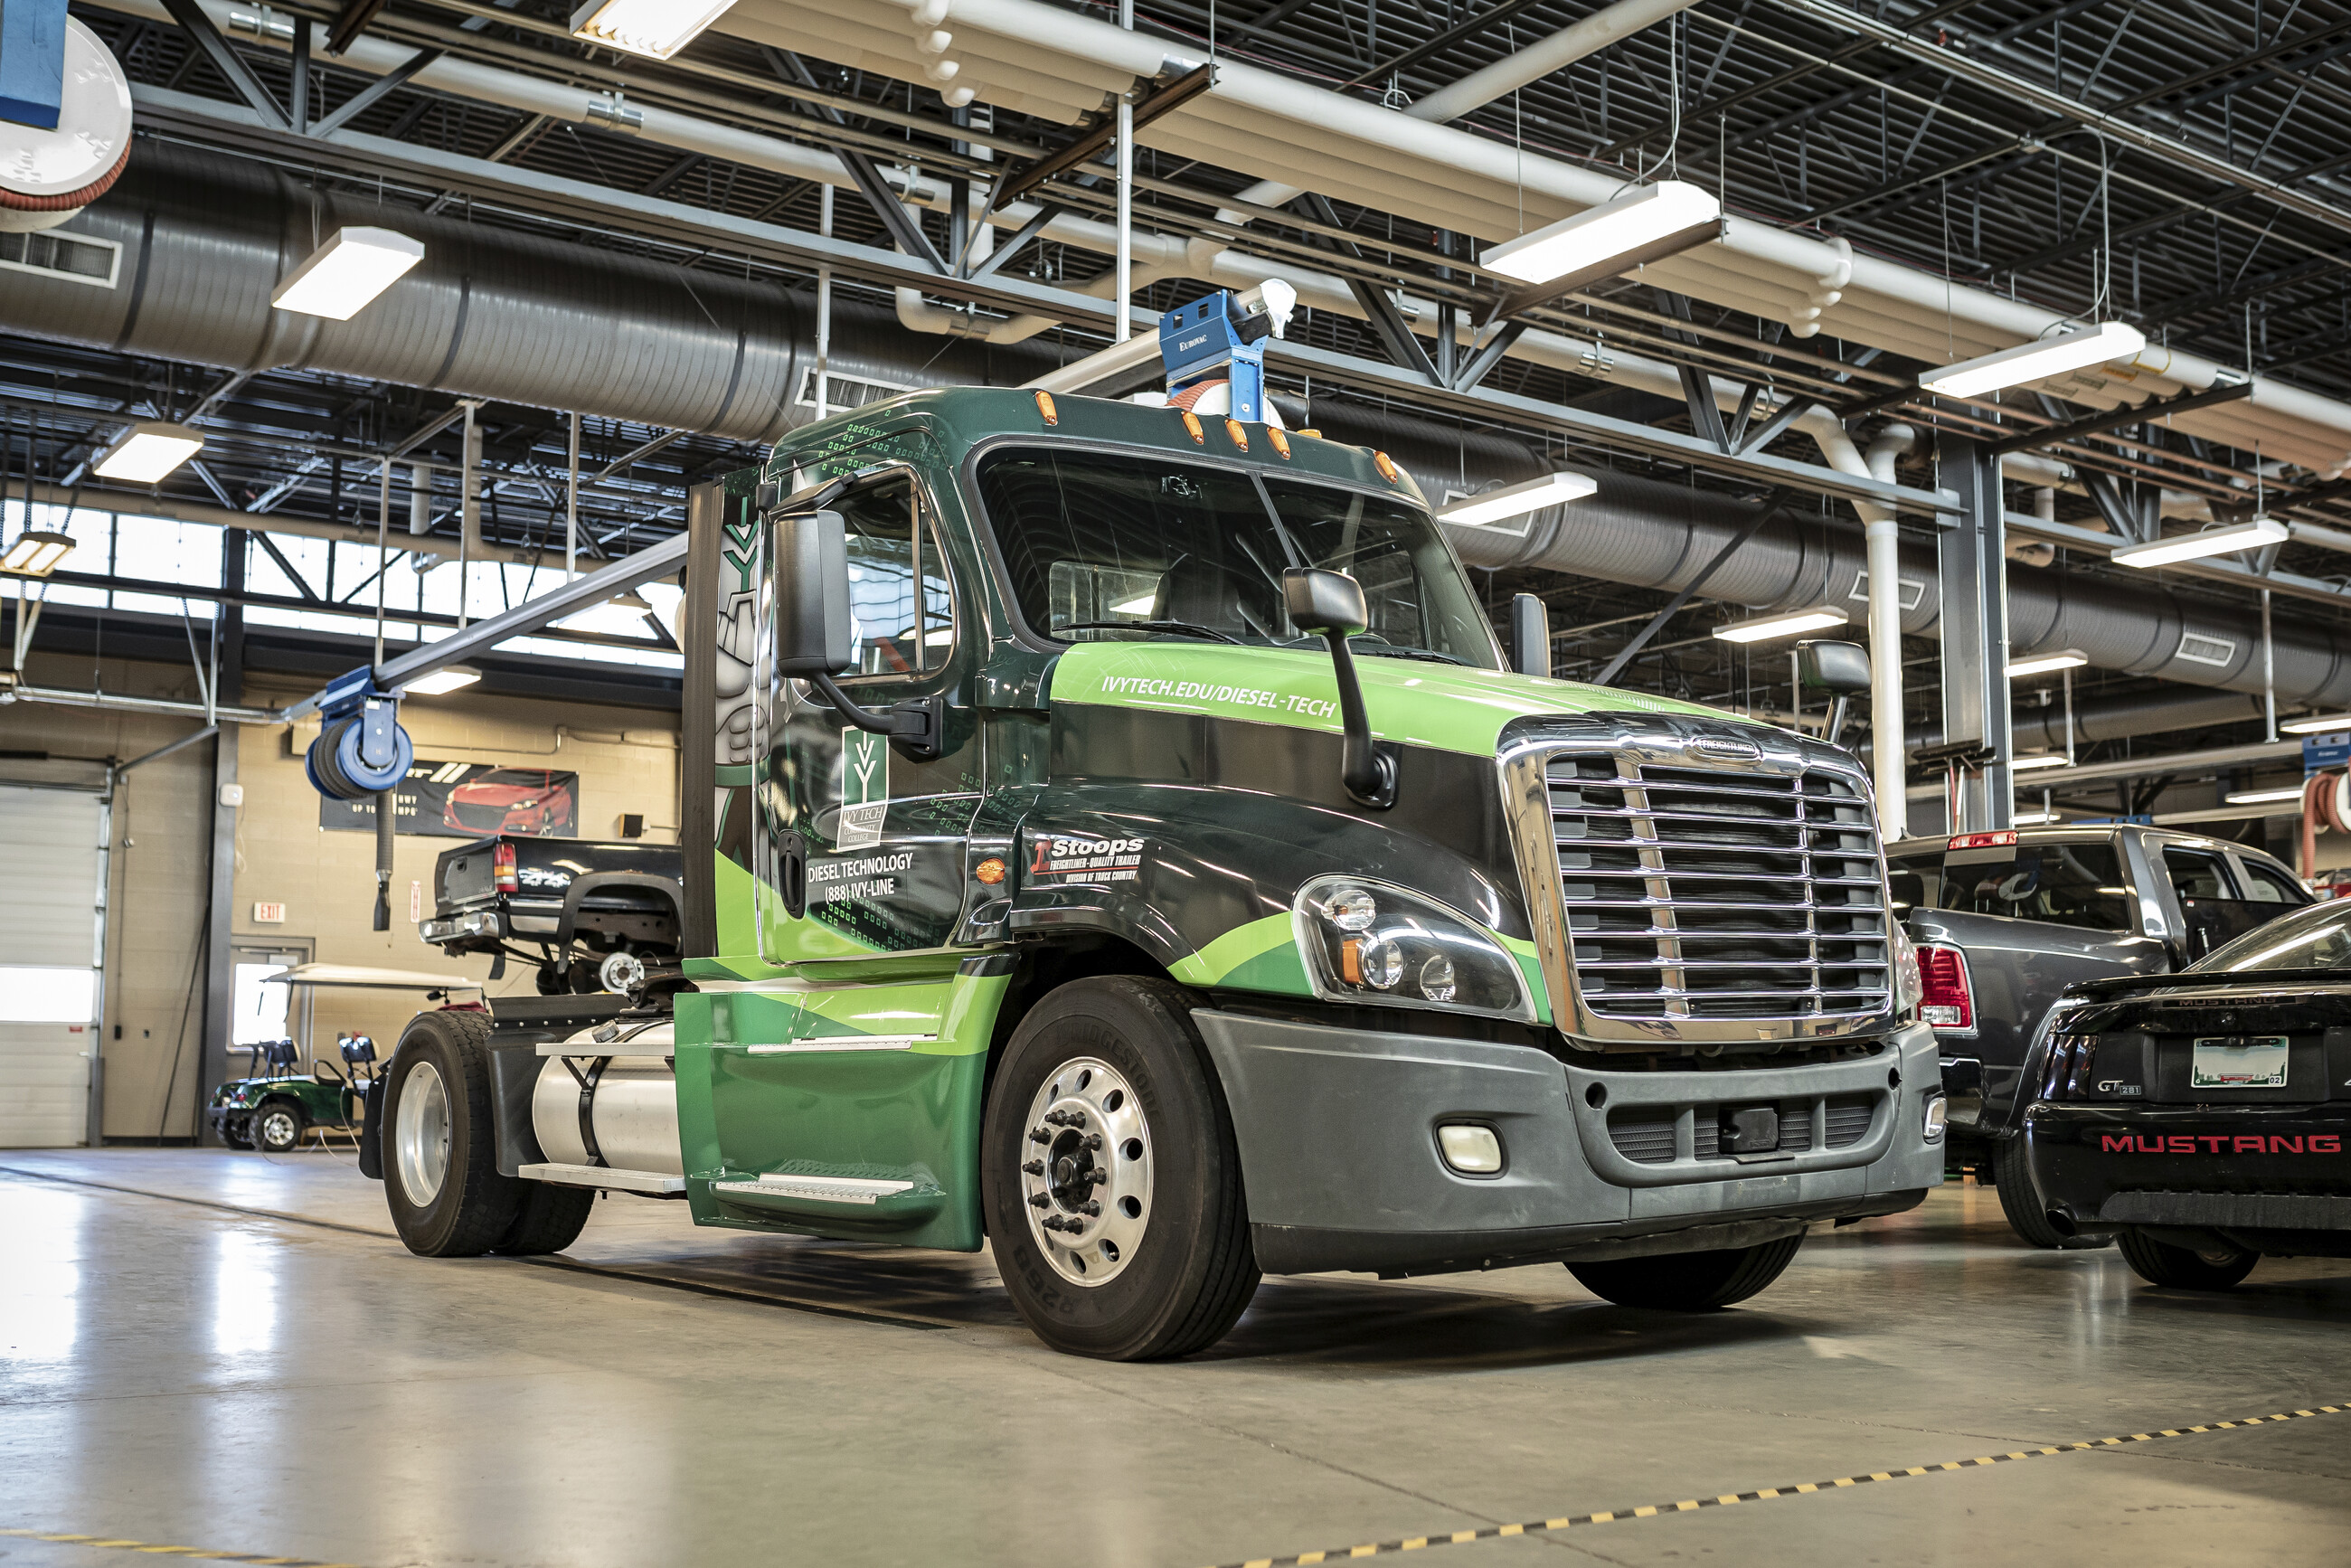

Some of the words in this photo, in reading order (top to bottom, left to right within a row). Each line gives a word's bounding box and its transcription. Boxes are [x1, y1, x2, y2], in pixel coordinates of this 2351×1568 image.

[1101, 676, 1336, 718] IVYTECH.EDU/DIESEL-TECH
[843, 810, 858, 823] IVY
[860, 807, 883, 820] TECH
[847, 832, 869, 843] COLLEGE
[1052, 838, 1145, 857] Stoops
[807, 863, 840, 883] DIESEL
[841, 853, 913, 877] TECHNOLOGY
[1115, 855, 1141, 866] TRAILER
[1111, 870, 1138, 881] COUNTRY
[825, 883, 850, 904] (888)
[851, 878, 895, 899] IVY-LINE
[260, 904, 280, 921] EXIT
[2178, 997, 2277, 1006] MUSTANG
[2098, 1080, 2123, 1092] GT
[2270, 1076, 2280, 1084] 02
[2101, 1135, 2342, 1154] MUSTANG
